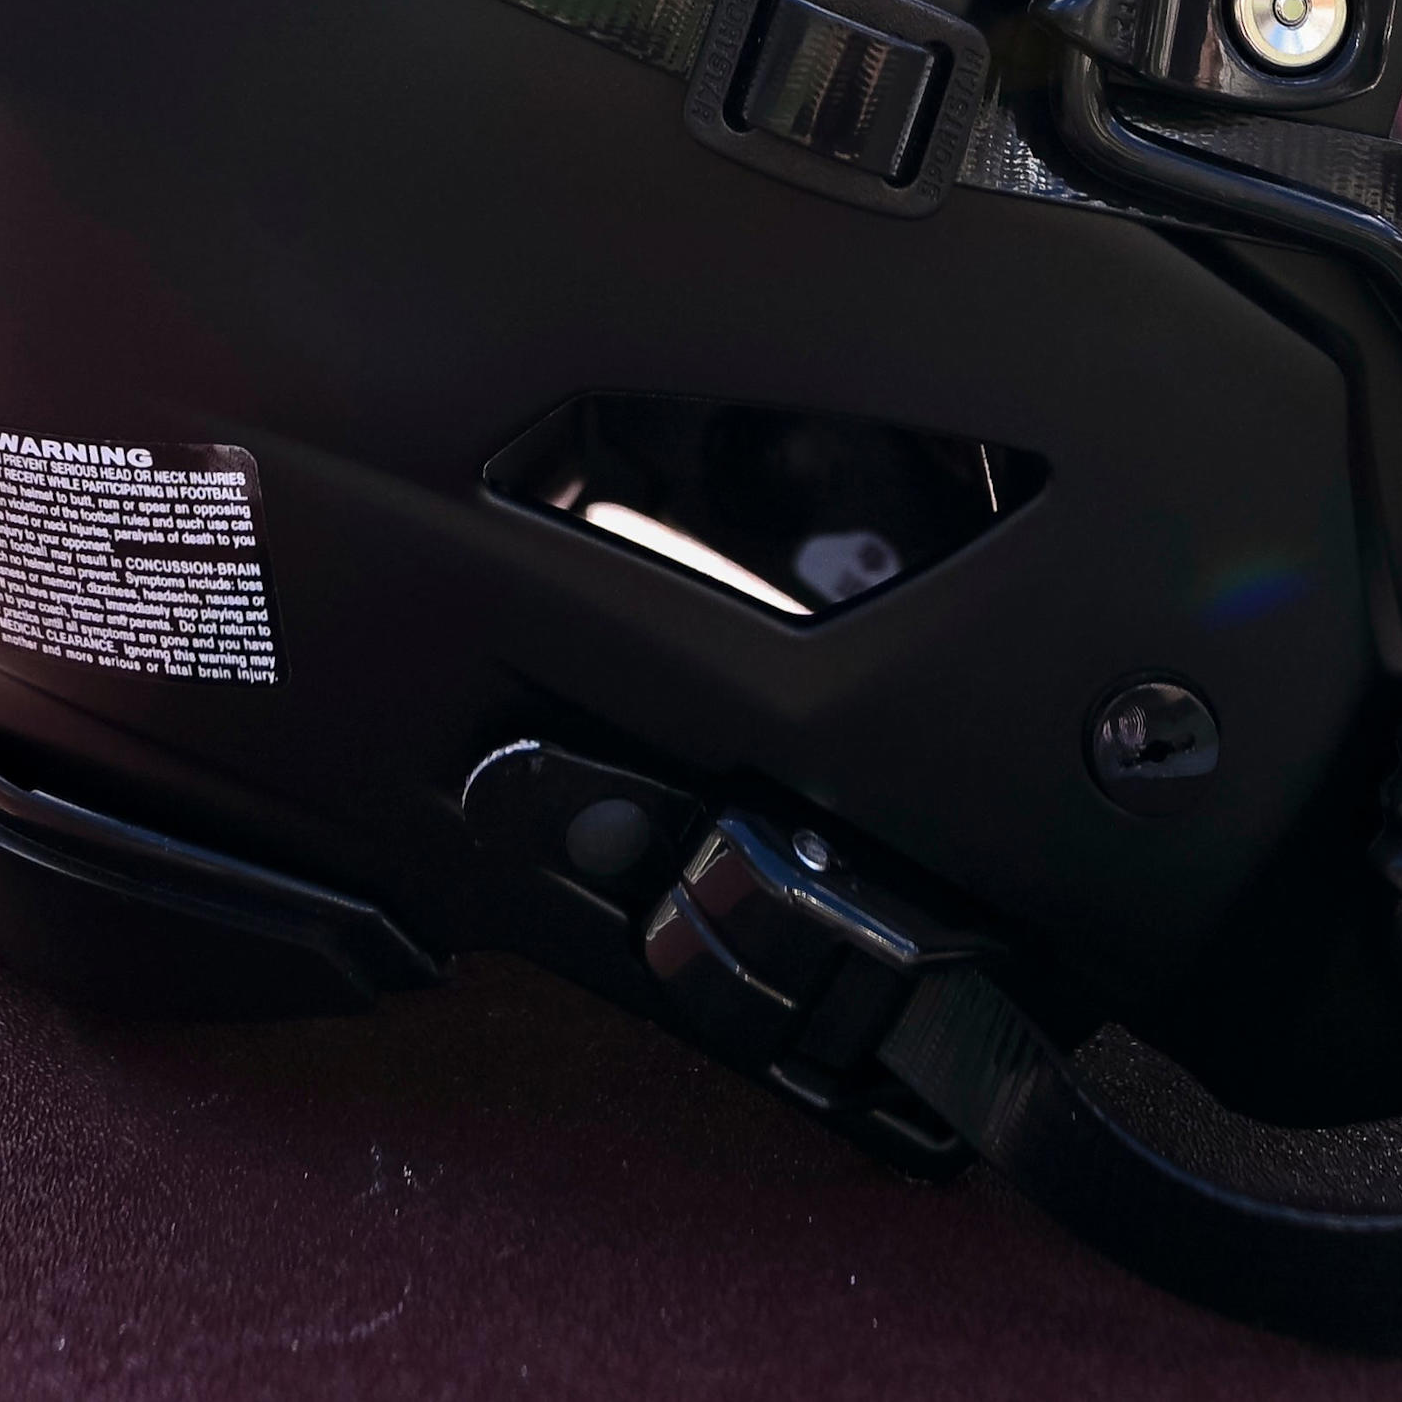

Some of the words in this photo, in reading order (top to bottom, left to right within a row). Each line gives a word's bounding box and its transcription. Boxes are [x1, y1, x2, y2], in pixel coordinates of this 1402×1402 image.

[2, 453, 48, 472] PREVENT
[49, 460, 98, 479] SERIOUS
[99, 466, 132, 481] HEAD
[133, 469, 152, 483] OR
[153, 470, 188, 485] NECK
[189, 472, 246, 486] INJURIES
[3, 467, 46, 486] RECEIVE
[46, 474, 81, 491] WHILE
[81, 479, 164, 498] PARTICIPATING
[165, 485, 179, 499] IN
[179, 486, 248, 501] FOOTBALL.
[7, 497, 49, 515] violation
[49, 505, 60, 517] of
[61, 506, 79, 520] the
[79, 508, 121, 524] football
[122, 513, 150, 527] rules
[152, 515, 174, 528] and
[175, 517, 205, 530] such
[206, 520, 229, 531] use
[230, 521, 253, 531] can
[19, 484, 54, 502] helmet
[55, 491, 68, 504] to
[69, 492, 95, 510] butt,
[97, 498, 120, 510] ram
[122, 501, 135, 511] or
[138, 502, 173, 517] spear
[174, 504, 190, 514] an
[192, 503, 251, 519] opposing
[5, 509, 29, 526] head
[30, 517, 41, 528] or
[43, 519, 68, 532] neck
[69, 521, 112, 542] injuries,
[113, 528, 165, 544] paralysis
[181, 531, 215, 545] death
[216, 532, 230, 546] to
[232, 536, 256, 549] you
[24, 528, 36, 541] to
[36, 532, 59, 546] your
[61, 536, 115, 557] opponent.
[8, 537, 48, 557] football
[50, 549, 72, 564] may
[75, 550, 108, 567] result
[110, 555, 122, 568] in
[125, 556, 261, 576] CONCUSSION-BRAIN
[9, 554, 22, 566] no
[22, 555, 56, 573] helmet
[57, 564, 76, 576] can
[77, 567, 121, 585] prevent.
[125, 571, 186, 592] Symptoms
[187, 576, 235, 591] include:
[236, 578, 263, 591] loss
[6, 581, 24, 594] you
[24, 582, 48, 599] have
[49, 590, 104, 611] symptoms,
[105, 597, 170, 619] immediately
[172, 605, 199, 621] stop
[200, 607, 244, 624] playing
[245, 608, 268, 622] and
[28, 572, 39, 583] or
[41, 575, 85, 594] memory,
[86, 581, 141, 603] dizziness,
[142, 587, 203, 606] headache,
[205, 594, 249, 606] nausea
[252, 596, 266, 606] or
[2, 607, 40, 627] practice
[41, 616, 64, 629] until
[65, 620, 78, 633] all
[80, 624, 136, 644] symptoms
[138, 633, 157, 645] are
[159, 635, 189, 651] gone
[192, 636, 215, 649] and
[217, 639, 241, 653] you
[243, 638, 273, 651] have
[4, 592, 15, 605] to
[15, 596, 36, 611] your
[38, 602, 70, 619] coach,
[70, 605, 104, 623] trainer
[128, 617, 174, 631] parents.
[178, 619, 196, 633] Do
[198, 621, 218, 634] not
[219, 622, 256, 636] return
[257, 623, 271, 636] to
[1, 632, 37, 650] another
[42, 644, 62, 656] and
[65, 649, 93, 663] more
[98, 655, 141, 671] serious
[146, 662, 159, 673] or
[164, 661, 193, 676] fatal
[197, 665, 231, 679] brain
[237, 667, 278, 684] injury.
[45, 628, 118, 654] CLEARANCE.
[123, 642, 171, 664] Ignoring
[172, 648, 196, 663] this
[198, 651, 247, 669] warning
[249, 656, 275, 669] may
